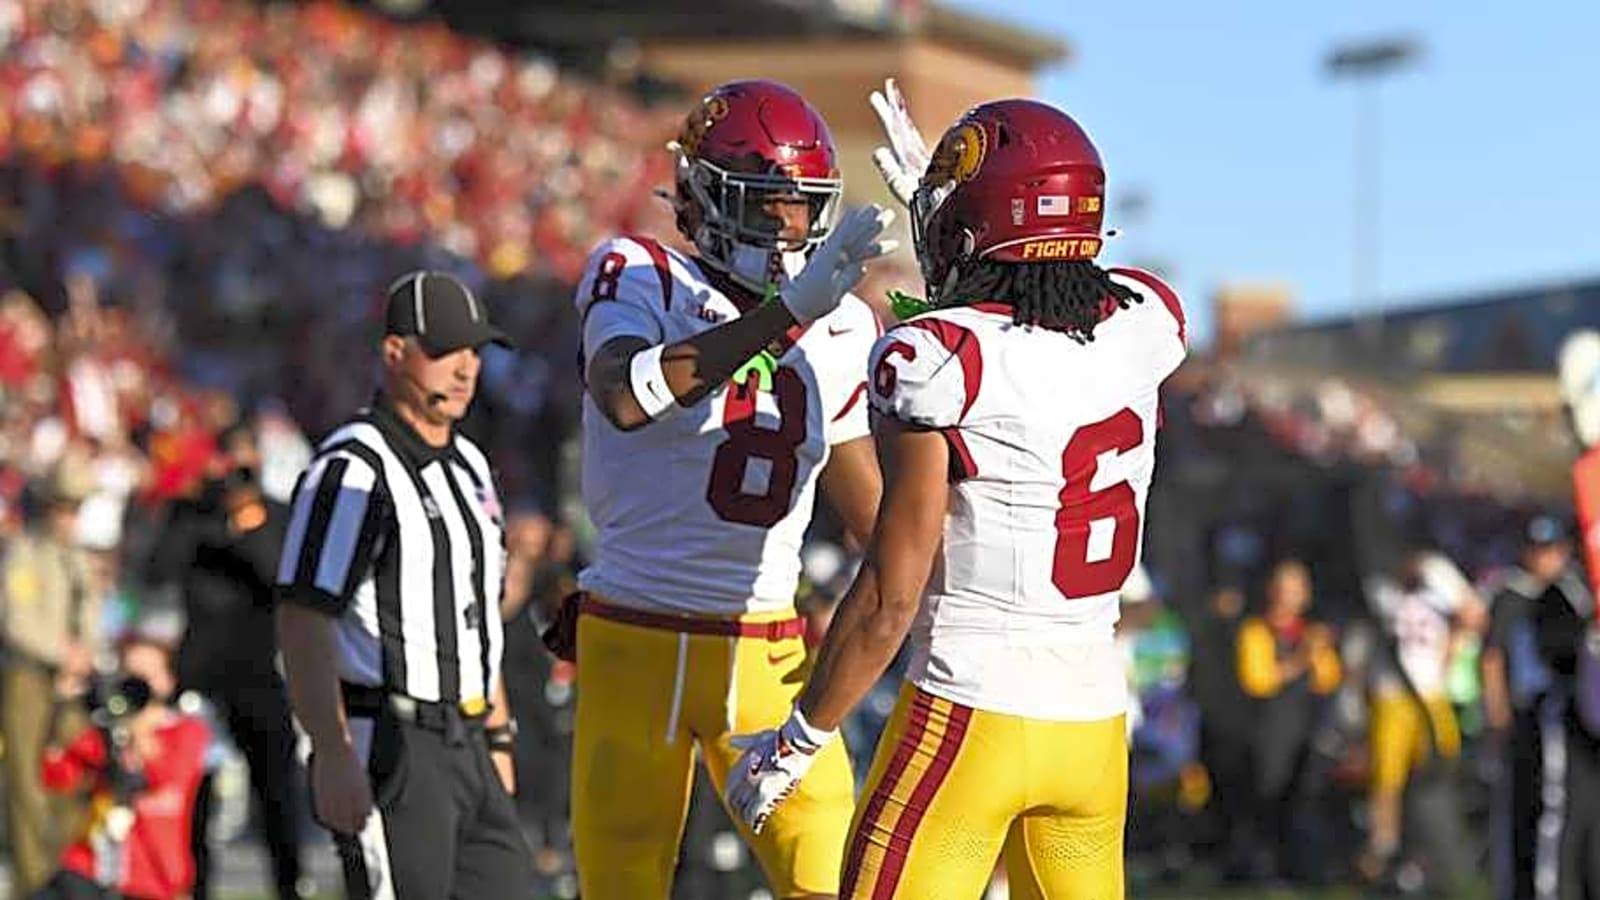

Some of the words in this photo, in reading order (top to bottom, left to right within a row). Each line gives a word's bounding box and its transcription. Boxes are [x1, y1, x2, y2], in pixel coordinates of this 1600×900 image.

[591, 252, 627, 301] 8
[1023, 240, 1078, 258] FIGHT
[874, 341, 917, 399] 6
[706, 364, 807, 529] 8
[1051, 406, 1144, 600] 6
